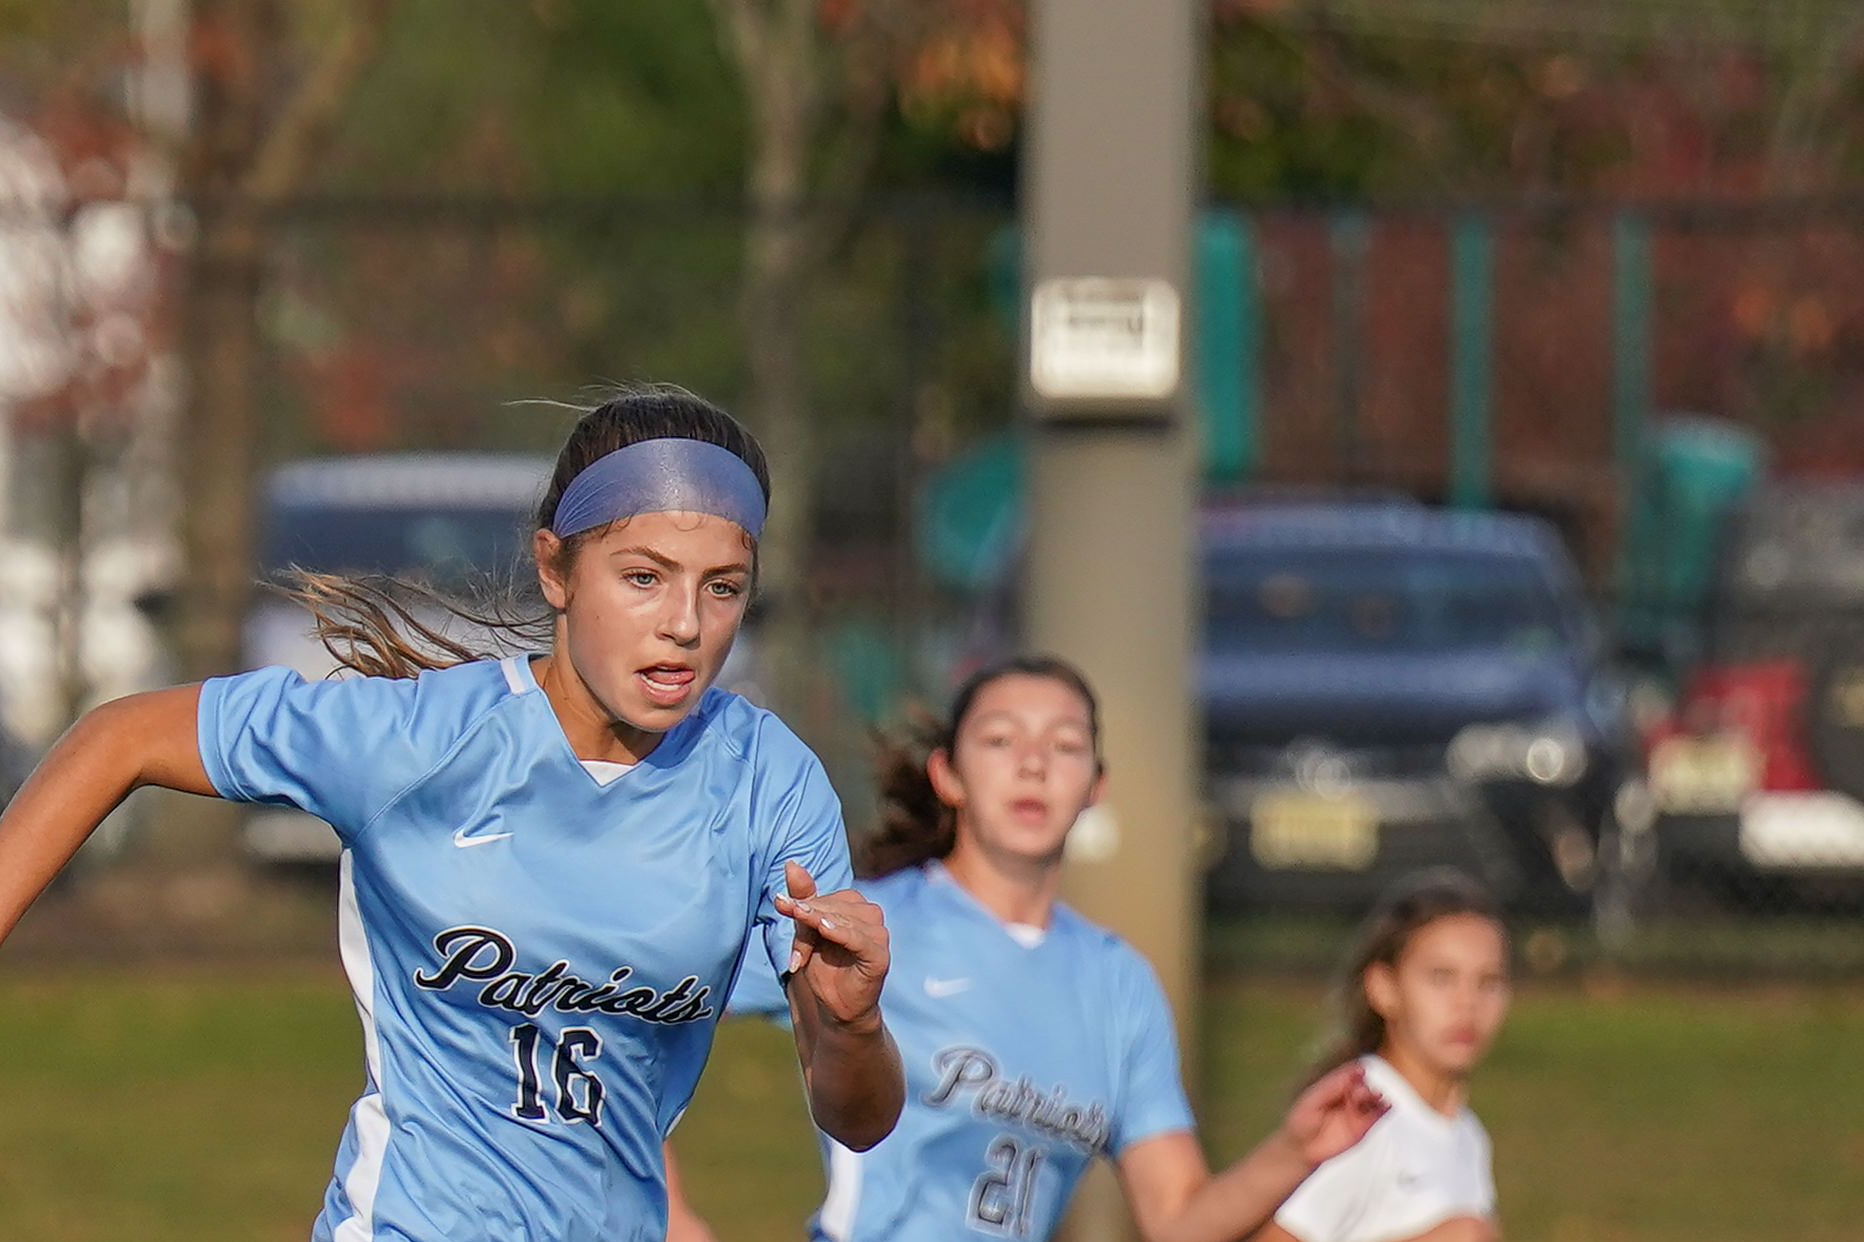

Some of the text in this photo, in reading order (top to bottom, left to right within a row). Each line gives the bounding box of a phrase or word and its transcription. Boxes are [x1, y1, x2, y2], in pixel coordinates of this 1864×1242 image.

[413, 924, 714, 1026] Patriots
[509, 1022, 606, 1127] 16
[965, 1132, 1045, 1242] 21
